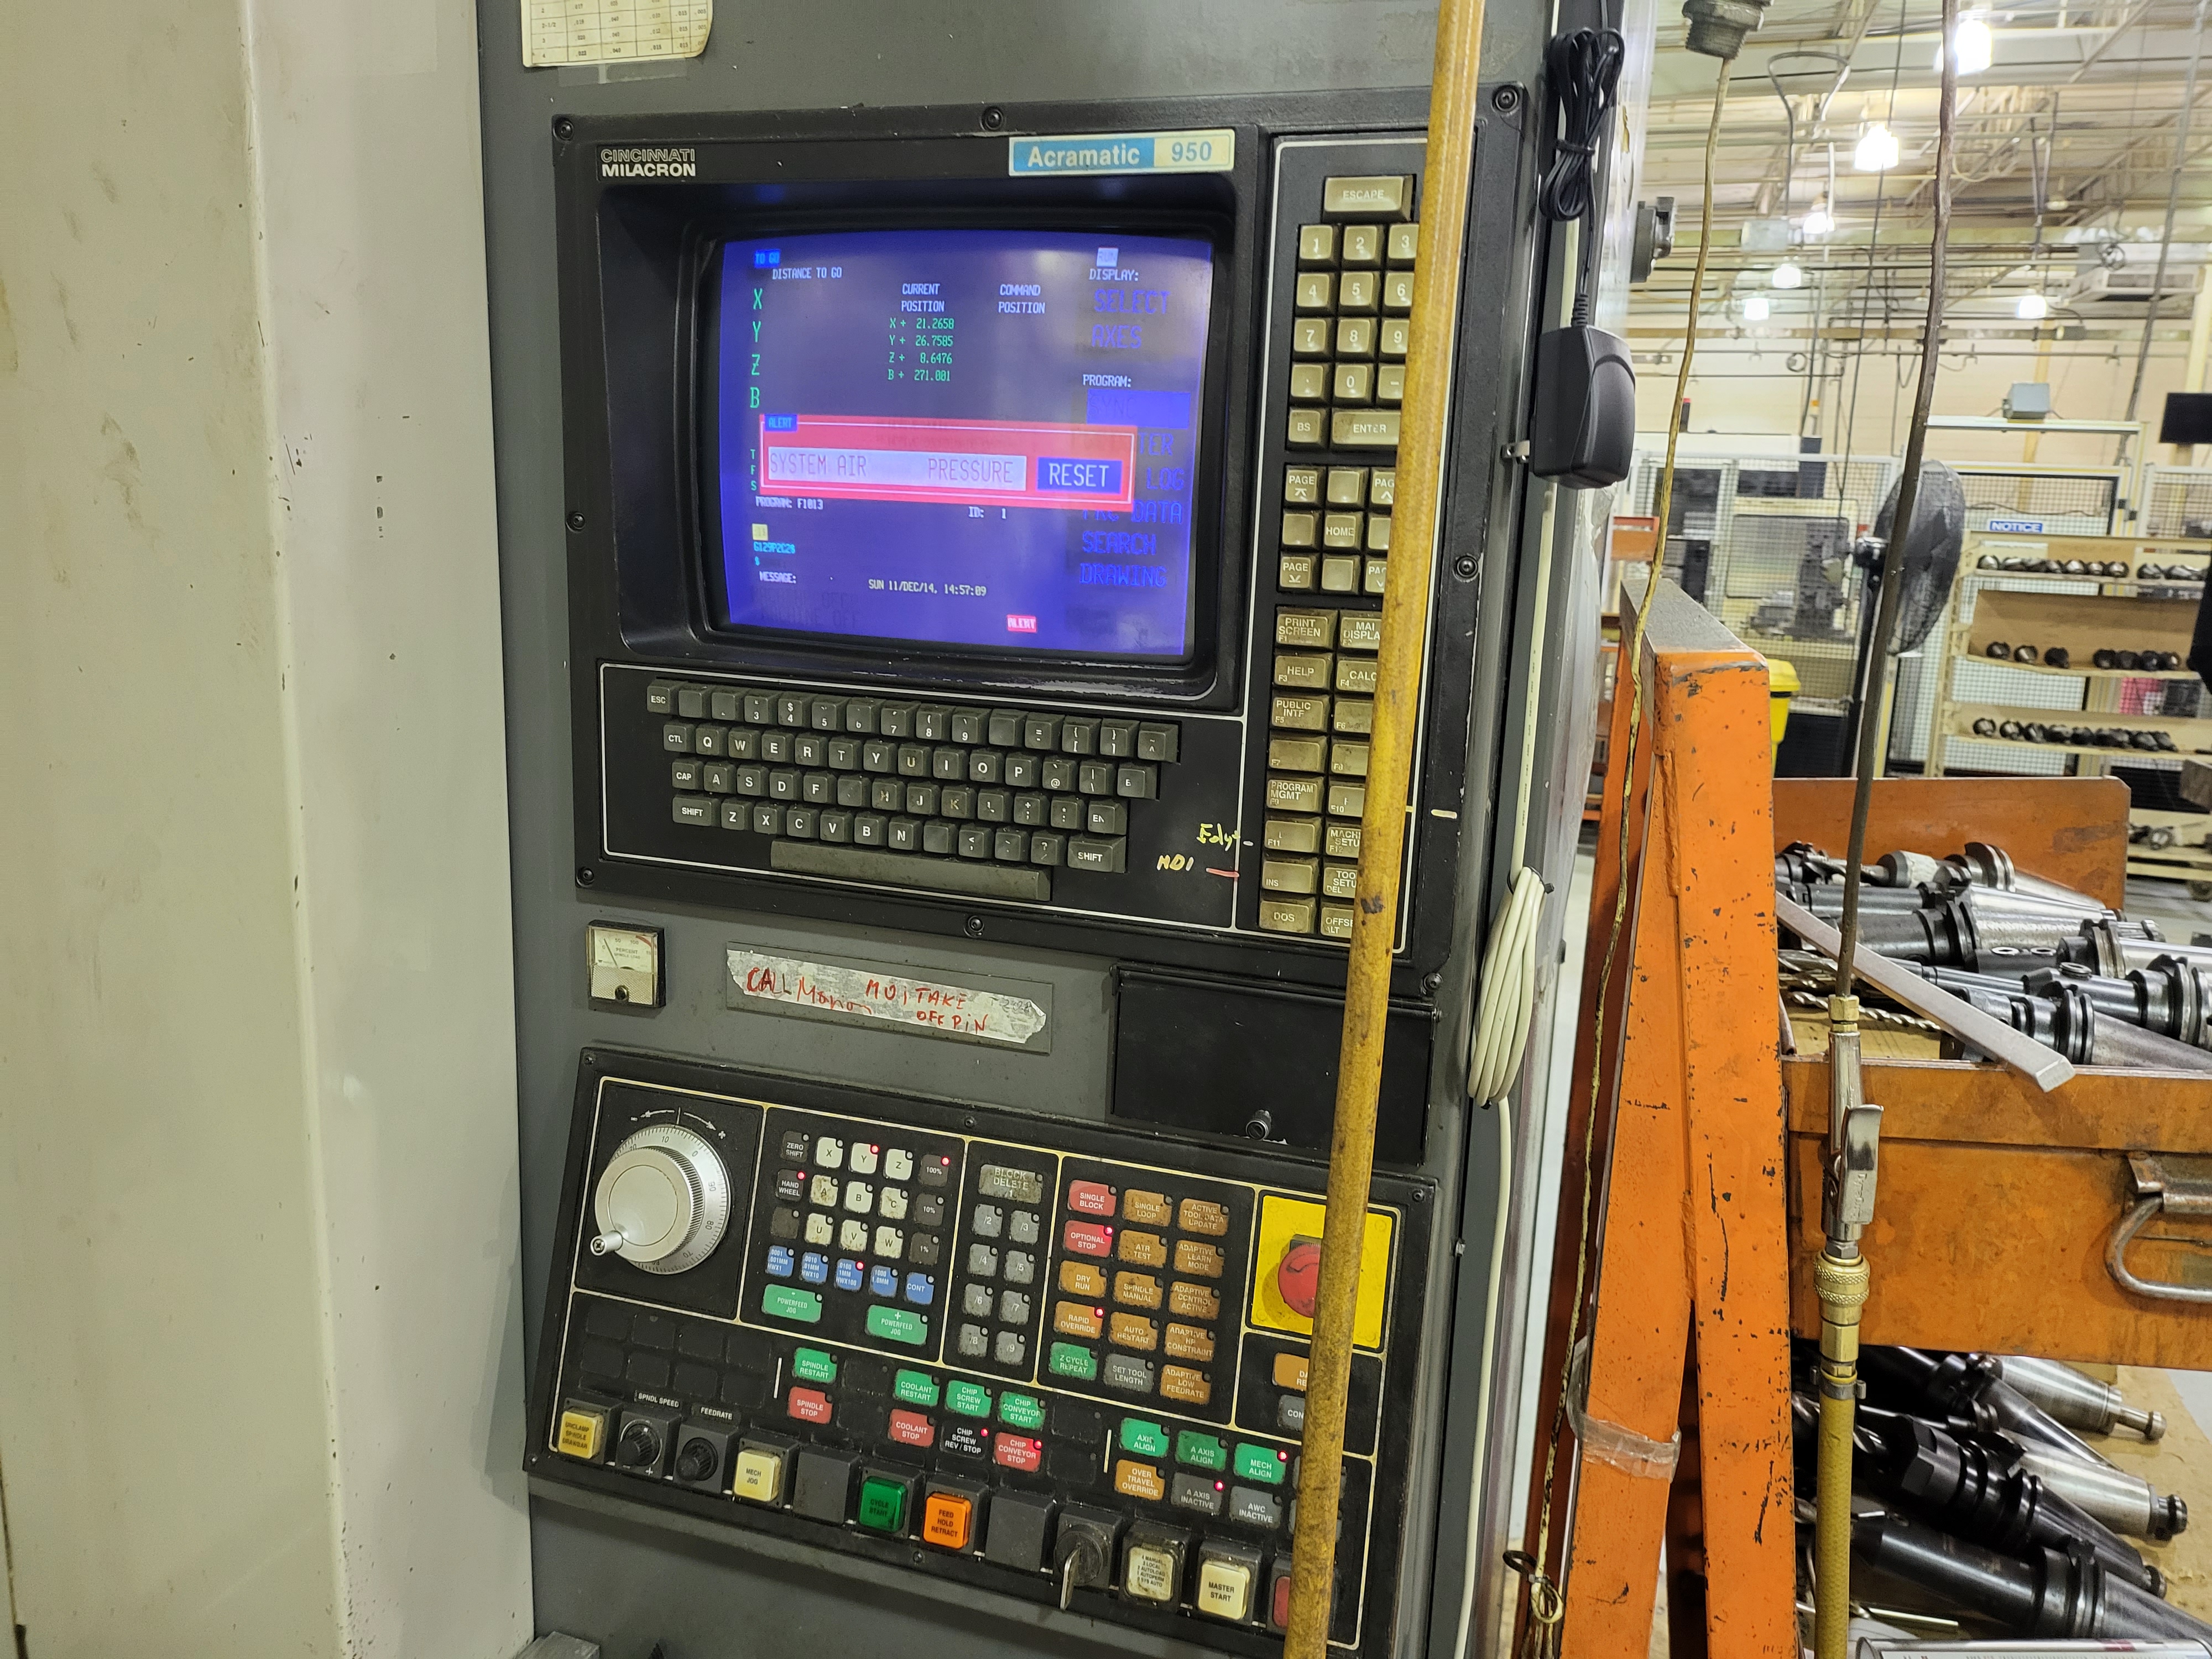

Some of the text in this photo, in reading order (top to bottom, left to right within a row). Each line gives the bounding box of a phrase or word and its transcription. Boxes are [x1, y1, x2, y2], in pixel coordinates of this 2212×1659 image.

[601, 149, 695, 163] CINCINNATI
[1027, 141, 1212, 167] Acramatic 950
[602, 163, 696, 176] MILACRON
[1343, 190, 1384, 200] ESCAPE
[1356, 237, 1364, 249] 2
[773, 267, 842, 279] DISTANCE TO GO
[1089, 269, 1139, 281] DISPLAY:
[902, 283, 940, 295] CURRENT
[1000, 285, 1040, 296] COMMAND
[1352, 283, 1360, 295] 5
[901, 301, 945, 312] POSITION
[1094, 289, 1170, 314] SELECT
[998, 302, 1045, 314] POSITION
[916, 318, 954, 330] 21.2658
[916, 335, 953, 347] 26.7585
[1092, 324, 1142, 348] AXES
[1350, 330, 1358, 342] 8
[1083, 374, 1131, 387] PROGRAM:
[769, 418, 792, 428] ALERT
[1297, 422, 1311, 431] BS
[1353, 424, 1386, 433] ENTER
[770, 453, 1013, 482] SYSTEM AIR PRESSURE
[1049, 463, 1109, 487] RESET
[1146, 468, 1185, 491] LOG
[1289, 476, 1314, 484] PAGE
[1375, 478, 1394, 487] PAG
[1131, 501, 1182, 524] DATA
[1326, 527, 1354, 536] HOME
[1991, 521, 2041, 533] NOTICE
[1082, 531, 1156, 555] SEARCH
[1283, 562, 1308, 572] PAGE
[1080, 563, 1167, 587] DRAWING
[869, 580, 987, 596] SUN 14:57:09
[1285, 618, 1315, 627] PRINT
[1279, 626, 1321, 637] SCREEN
[1287, 666, 1314, 675] HELP
[651, 695, 666, 704] ESC
[1276, 700, 1311, 709] PUBLIC
[1284, 709, 1304, 717] INTF
[669, 735, 682, 743] CTL
[703, 737, 712, 748] Q
[676, 772, 691, 781] CAP
[1272, 782, 1313, 793] PROGRAM
[1271, 790, 1301, 800] MGMT
[682, 807, 703, 817] SHIFT
[1078, 852, 1103, 862] SHIFT
[1327, 885, 1342, 894] DEL
[1274, 912, 1295, 921] DOS
[915, 988, 967, 1010] TAKE
[786, 1149, 803, 1158] SHIFT
[926, 1166, 942, 1175] 100%
[781, 1180, 799, 1188] HAND
[994, 1178, 1029, 1190] DELETE
[779, 1186, 800, 1196] WHEEL
[1080, 1192, 1105, 1203] SINGLE
[923, 1206, 936, 1214] 10%
[1079, 1200, 1103, 1210] BLOCK
[1135, 1202, 1160, 1212] SINGLE
[1191, 1203, 1217, 1213] ACTIVE
[1137, 1211, 1156, 1219] LOOP
[1189, 1219, 1217, 1229] UPDATE
[1071, 1232, 1105, 1244] OPTIONAL
[1078, 1241, 1097, 1250] STOP
[1178, 1244, 1214, 1255] ADAPTIVE
[1134, 1251, 1151, 1260] TEST
[1187, 1253, 1211, 1263] LEARN
[1188, 1261, 1209, 1270] MODE
[1076, 1274, 1091, 1282] DRY
[907, 1283, 925, 1292] CONT
[1076, 1282, 1090, 1290] RUN
[1124, 1284, 1154, 1295] SPINDLE
[1123, 1291, 1152, 1302] MANUAL
[778, 1297, 807, 1309] POWERFEED
[881, 1318, 912, 1331] POWERFEED
[1068, 1314, 1089, 1324] RAPID
[1061, 1321, 1095, 1333] OVERRIDE
[1124, 1326, 1144, 1334] AUTO
[1167, 1342, 1213, 1357] CONSTRAINT
[802, 1359, 828, 1371] SPINDLE
[1060, 1363, 1088, 1374] REPEAT
[800, 1367, 829, 1379] RESTART
[1128, 1368, 1147, 1378] TOOL
[1115, 1374, 1144, 1385] LENGTH
[1178, 1379, 1194, 1387] LOW
[901, 1381, 932, 1394] COOLANT
[961, 1386, 978, 1396] CHIP
[1166, 1385, 1204, 1398] FEEDRATE
[900, 1389, 931, 1401] RESTART
[956, 1393, 981, 1405] SCREW
[659, 1397, 679, 1408] SPEED
[797, 1400, 823, 1411] SPINDLE
[957, 1401, 979, 1412] START
[701, 1407, 733, 1420] FEEDRATE
[801, 1407, 818, 1417] STOP
[1003, 1404, 1041, 1418] CONVEYOR
[1010, 1413, 1032, 1424] START
[895, 1421, 927, 1434] COOLANT
[901, 1431, 920, 1440] STOP
[952, 1434, 977, 1446] SCREW
[1010, 1439, 1026, 1448] CHIP
[1134, 1441, 1156, 1453] ALIGN
[998, 1444, 1036, 1459] CONVEYOR
[1007, 1454, 1026, 1464] STOP
[1191, 1453, 1213, 1465] ALIGN
[1250, 1459, 1272, 1469] MECH
[746, 1468, 761, 1477] MECH
[1132, 1468, 1152, 1478] OVER
[1249, 1467, 1272, 1478] ALIGN
[747, 1477, 758, 1485] JOG
[1128, 1475, 1155, 1488] TRAVEL
[1122, 1483, 1159, 1496] OVERRIDE
[1181, 1495, 1214, 1510] INACTIVE
[1248, 1503, 1266, 1513] AWC
[939, 1509, 954, 1519] FEED
[1239, 1509, 1273, 1523] INACTIVE
[937, 1518, 953, 1528] HOLD
[931, 1525, 958, 1538] RETRACT
[1208, 1581, 1234, 1594] MASTER
[1211, 1591, 1231, 1603] START
